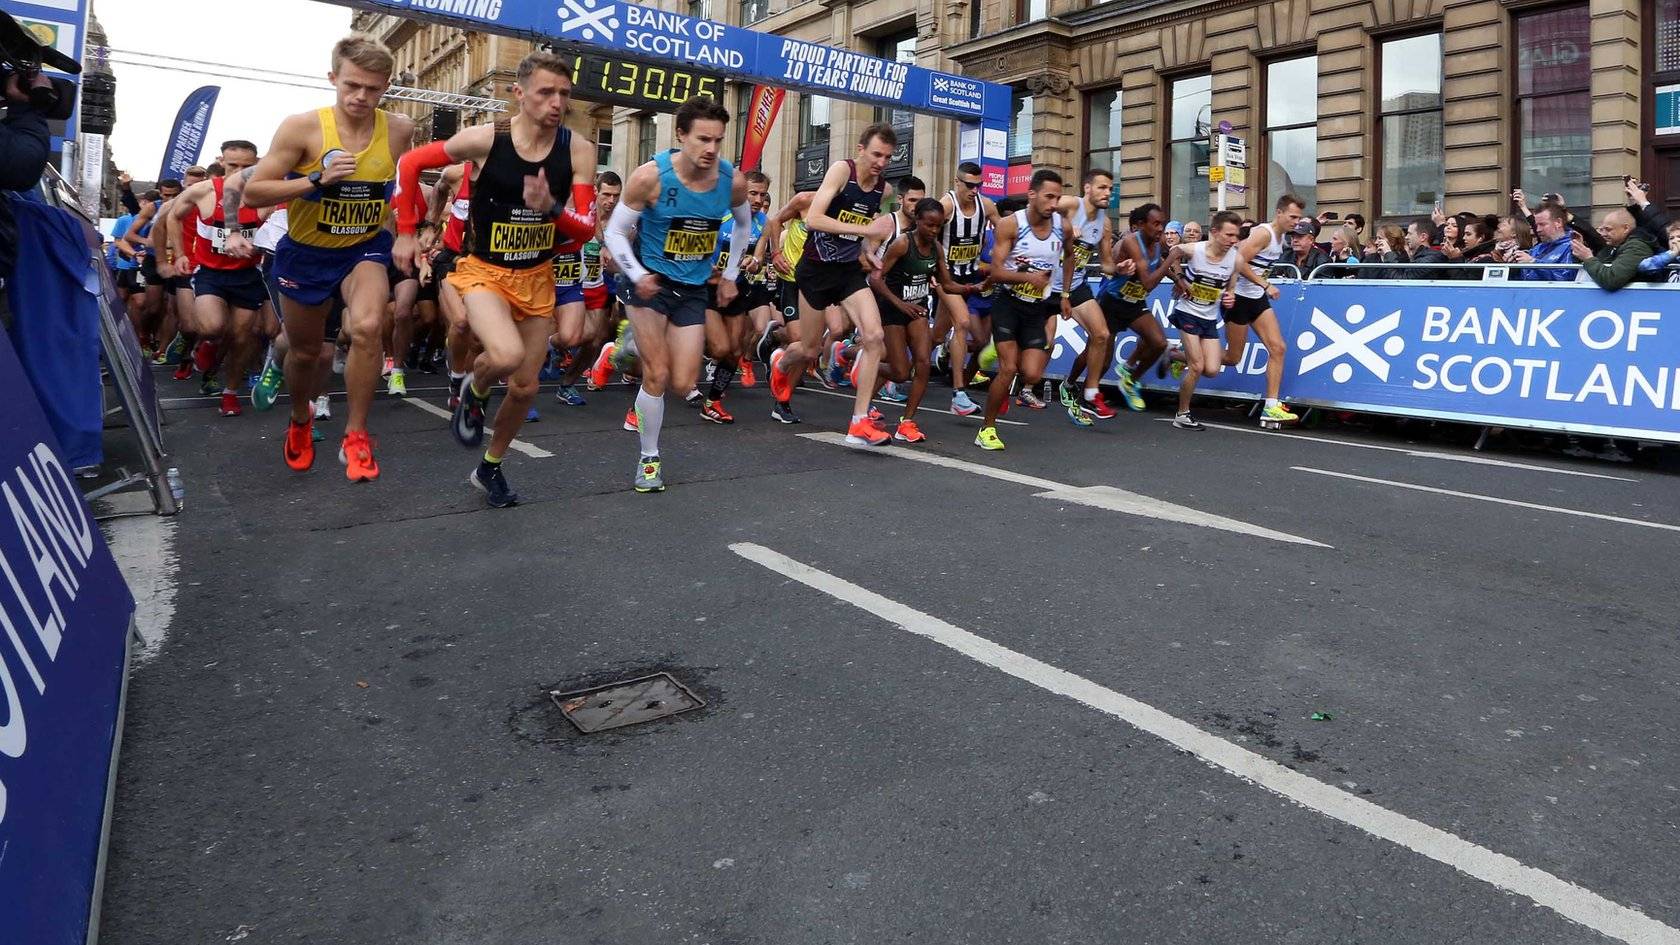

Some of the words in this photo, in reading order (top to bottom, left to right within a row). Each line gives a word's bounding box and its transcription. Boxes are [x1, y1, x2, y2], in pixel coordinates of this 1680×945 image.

[627, 6, 690, 36] BANK
[695, 21, 725, 42] OF
[625, 30, 744, 68] SCOTLAND
[781, 40, 825, 66] PROUD
[827, 50, 882, 77] PARTNER
[884, 62, 908, 83] FOR
[784, 60, 804, 80] 10
[807, 64, 849, 89] YEARS
[850, 74, 903, 100] RUNNING
[950, 80, 966, 89] BANK
[932, 95, 947, 104] Great
[971, 101, 981, 110] Run
[950, 87, 981, 99] SCOTLAND
[753, 106, 769, 137] DEEP
[176, 120, 192, 150] PARTNER
[170, 149, 184, 173] PROUD
[322, 200, 381, 225] TRAYNOR
[331, 226, 368, 234] GLASGOW
[495, 225, 552, 250] CHABOWSKI
[667, 231, 716, 253] THOMPSON
[504, 251, 539, 261] GLASGOW
[1421, 306, 1565, 348] BANK
[1579, 310, 1661, 351] OF
[1413, 354, 1680, 410] SCOTLAN
